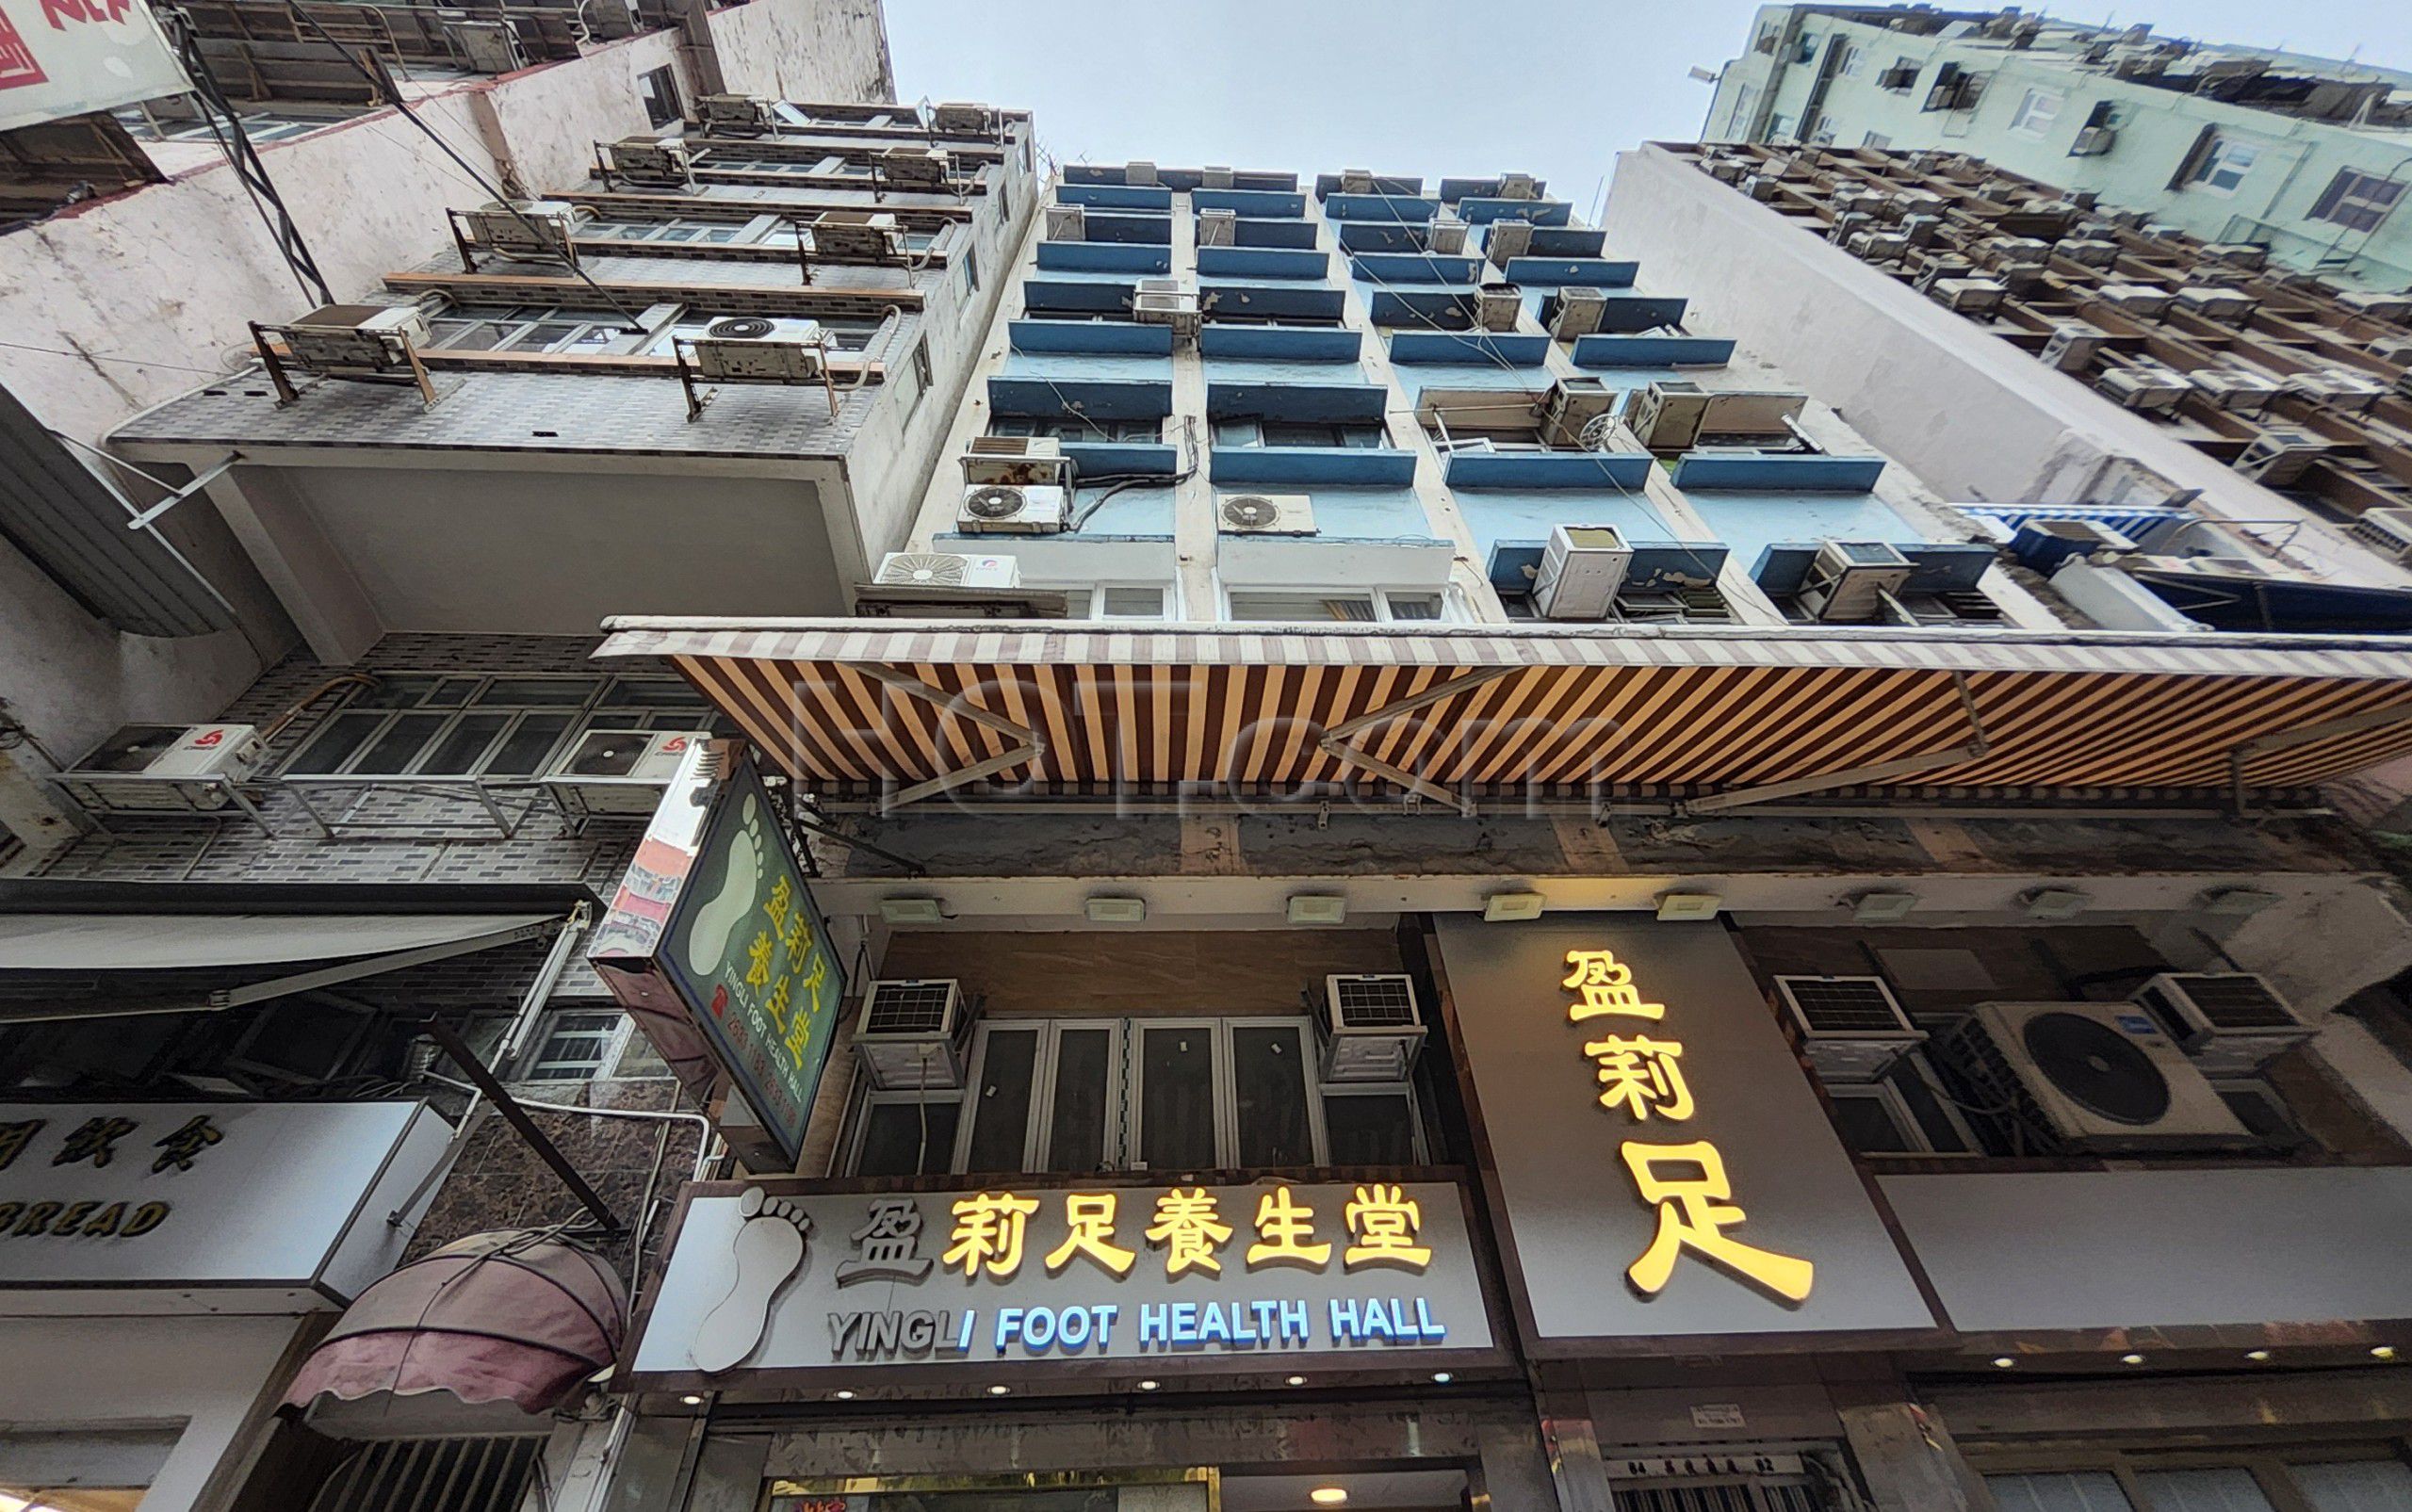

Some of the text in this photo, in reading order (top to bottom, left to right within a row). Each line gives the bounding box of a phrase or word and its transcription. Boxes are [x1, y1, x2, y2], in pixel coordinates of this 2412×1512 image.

[745, 930, 810, 1071] 養生堂
[763, 874, 825, 1014] 盈莉足
[724, 961, 803, 1104] YINGLI FOOT HEALTH HALL
[1561, 950, 1815, 1306] 盈莉足
[836, 1184, 1433, 1287] 盈莉足養生堂
[828, 1295, 1447, 1360] YINGLI FOOT HEALTH HALL
